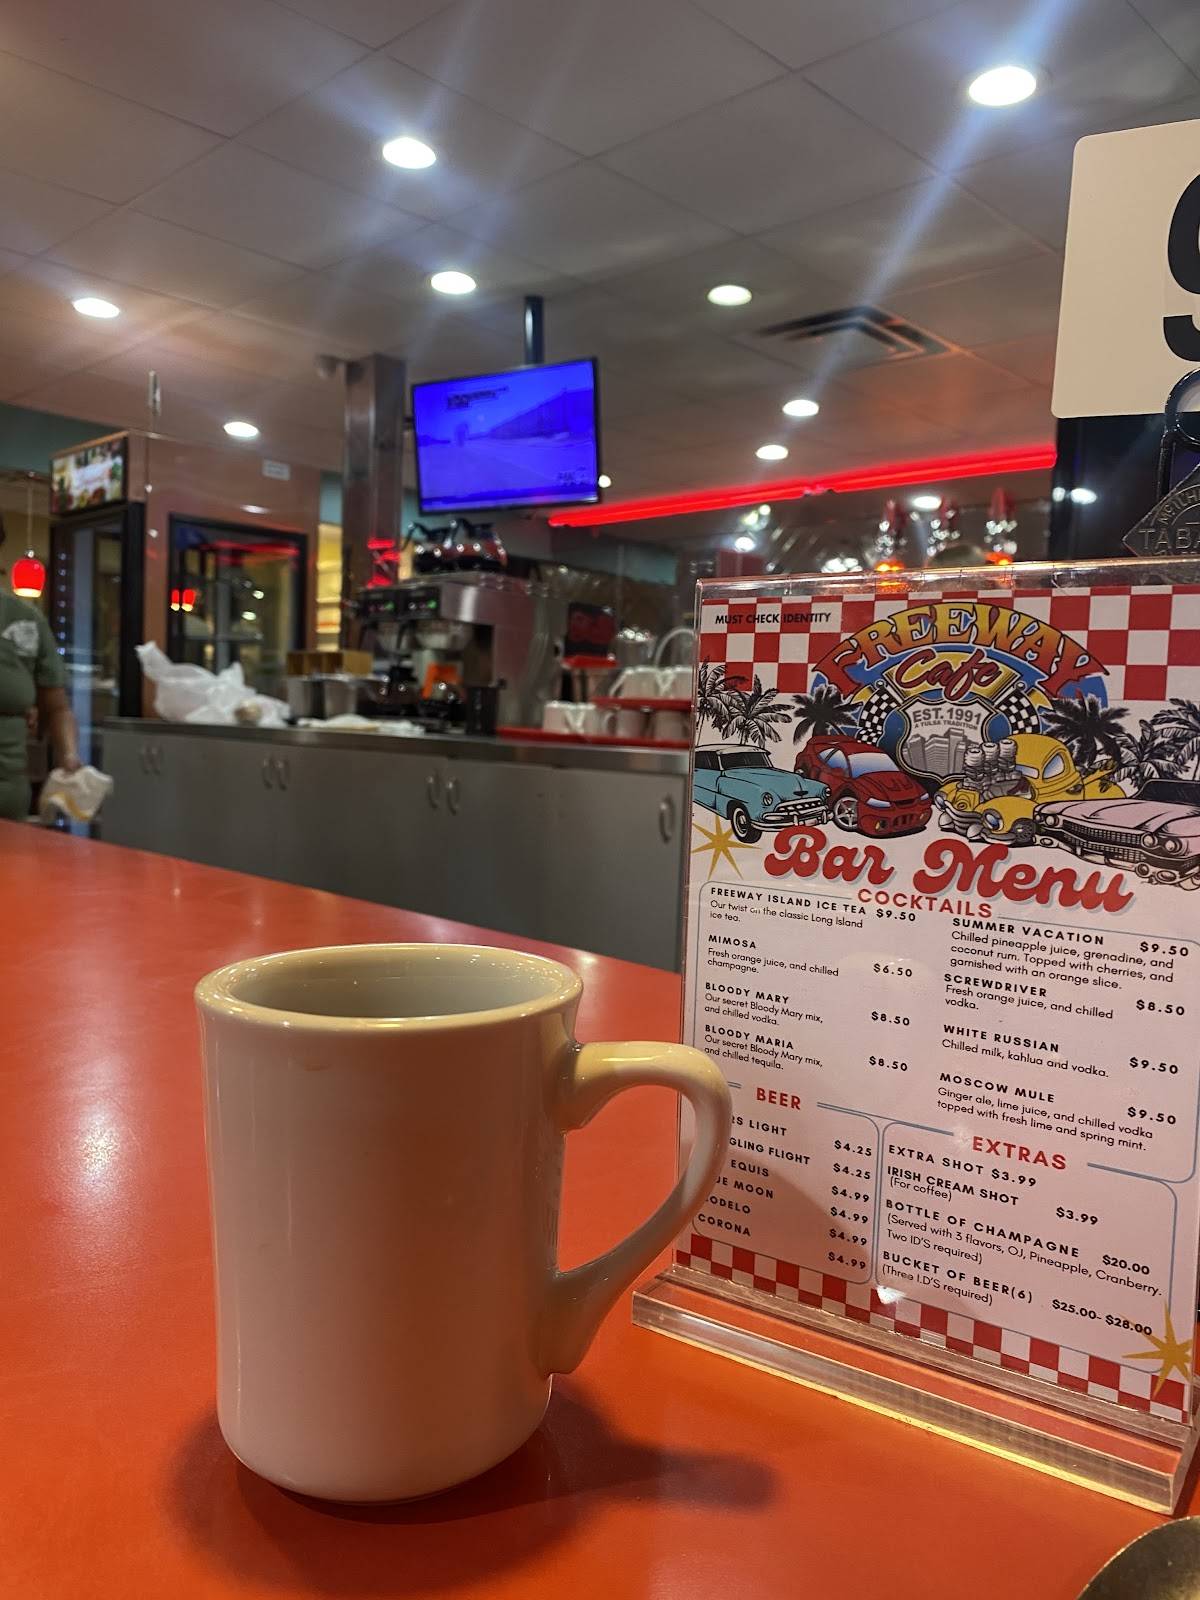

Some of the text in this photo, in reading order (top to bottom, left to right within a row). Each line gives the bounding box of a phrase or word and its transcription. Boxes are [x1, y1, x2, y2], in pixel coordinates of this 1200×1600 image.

[715, 613, 831, 624] MUST CHECK IDENTITY
[812, 602, 1110, 701] FREEWAY
[912, 708, 981, 725] EST. 1991
[944, 720, 977, 730] TRADITION
[763, 826, 1134, 913] Bar Menu
[711, 887, 916, 922] FREEWAY ISLAND ICE TEA $9.50
[711, 901, 725, 909] Our
[728, 903, 747, 912] twist
[763, 908, 776, 916] the
[779, 910, 808, 921] classic
[811, 914, 833, 925] Long
[836, 917, 863, 928] Island
[858, 888, 992, 919] COCKTAILS
[710, 912, 740, 922] ice tea.
[708, 935, 756, 949] MIMOSA
[952, 918, 1104, 945] SUMMER VACATION
[952, 931, 1173, 969] Chilled pineapple juice, grenadine, and
[1140, 941, 1189, 957] $9.50
[708, 948, 839, 977] Fresh orange juice, and chilled
[708, 959, 759, 974] champagne.
[873, 963, 912, 977] $6.50
[951, 944, 1173, 983] coconut rum. Topped with cherries, and
[944, 973, 1046, 997] SCREWDRIVER
[950, 958, 1122, 990] garnished with an orange slice.
[705, 982, 789, 1004] BLOODY MARY
[945, 997, 979, 1010] vodka.
[946, 984, 1113, 1019] Fresh orange juice, and chilled
[705, 993, 823, 1023] Our secret Bloody Mary mix,
[705, 1005, 779, 1025] and chilled vodka.
[871, 1011, 910, 1026] $8.50
[1136, 1000, 1184, 1016] $8.50
[705, 1024, 794, 1049] BLOODY MARIA
[943, 1025, 1059, 1052] WHITE RUSSIAN
[705, 1035, 823, 1067] Our secret Bloody Mary mix,
[705, 1047, 783, 1070] and chilled tequila.
[942, 1039, 1108, 1078] Chilled milk, kahlua and vodka.
[869, 1055, 908, 1071] $8.50
[1130, 1057, 1178, 1074] $9.50
[757, 1088, 800, 1110] BEER
[940, 1073, 1055, 1103] MOSCOW MULE
[938, 1087, 1153, 1139] Ginger ale, lime juice, and chilled vodka
[1127, 1106, 1176, 1125] $9.50
[750, 1120, 787, 1136] LIGHT
[938, 1100, 1146, 1151] topped with fresh lime and spring mint.
[769, 1148, 810, 1165] FLIGHT
[834, 1140, 872, 1156] $4.25
[972, 1136, 1067, 1170] EXTRAS
[731, 1160, 769, 1177] EQUIS
[833, 1163, 871, 1179] $4.25
[889, 1145, 1037, 1187] EXTRA SHOT $3.99
[734, 1180, 774, 1199] MOON
[831, 1186, 869, 1202] $4.99
[888, 1166, 1018, 1206] IRISH CREAM SHOT
[890, 1176, 952, 1201] (For coffee)
[706, 1196, 750, 1213] ODELO
[830, 1207, 868, 1224] $4.99
[698, 1213, 750, 1236] CORONA
[1056, 1206, 1098, 1226] $3.99
[829, 1229, 867, 1245] $4.99
[886, 1199, 1079, 1257] BOTTLE OF CHAMPAGNE
[887, 1229, 983, 1264] Two ID'S required)
[888, 1213, 1162, 1297] (Served with 3 flavors, OJ, Pineapple, Cranberry.
[828, 1252, 866, 1269] $4.99
[1102, 1254, 1150, 1275] $20.00
[883, 1251, 1032, 1303] BUCKET OF BEER(6)
[944, 1282, 993, 1305] required)
[1106, 1314, 1153, 1336] $28.00
